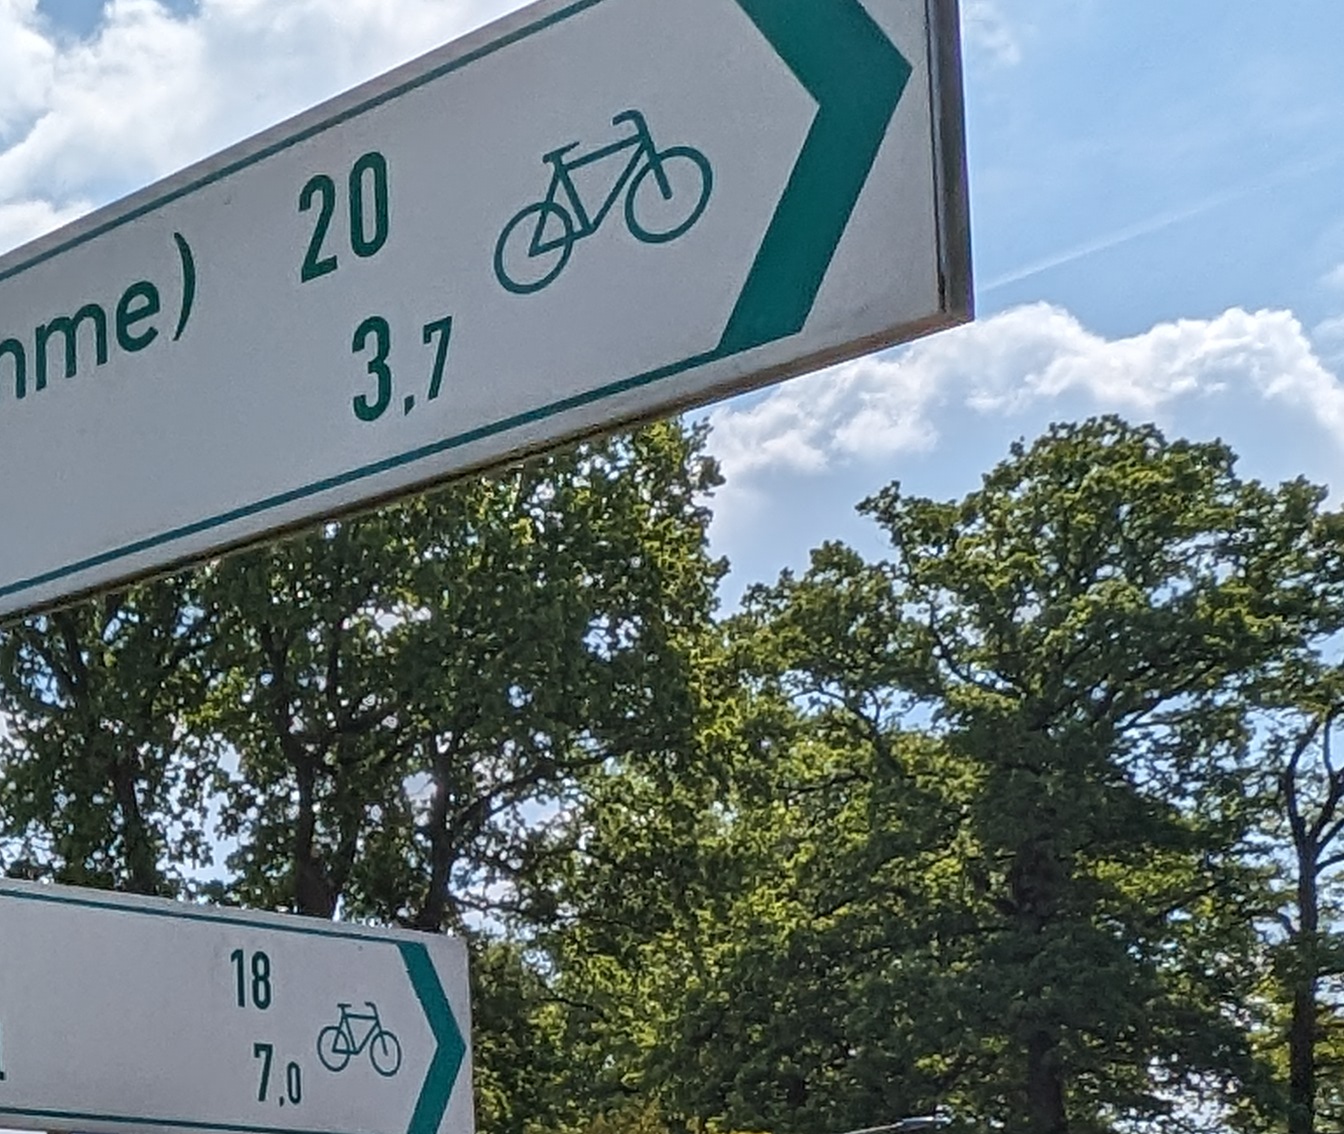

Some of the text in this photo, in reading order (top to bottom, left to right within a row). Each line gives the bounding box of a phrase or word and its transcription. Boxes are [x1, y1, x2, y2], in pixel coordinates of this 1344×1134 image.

[298, 151, 389, 283] 20
[352, 315, 452, 422] 3,7
[230, 949, 272, 1010] 18
[253, 1042, 302, 1108] 7,0
